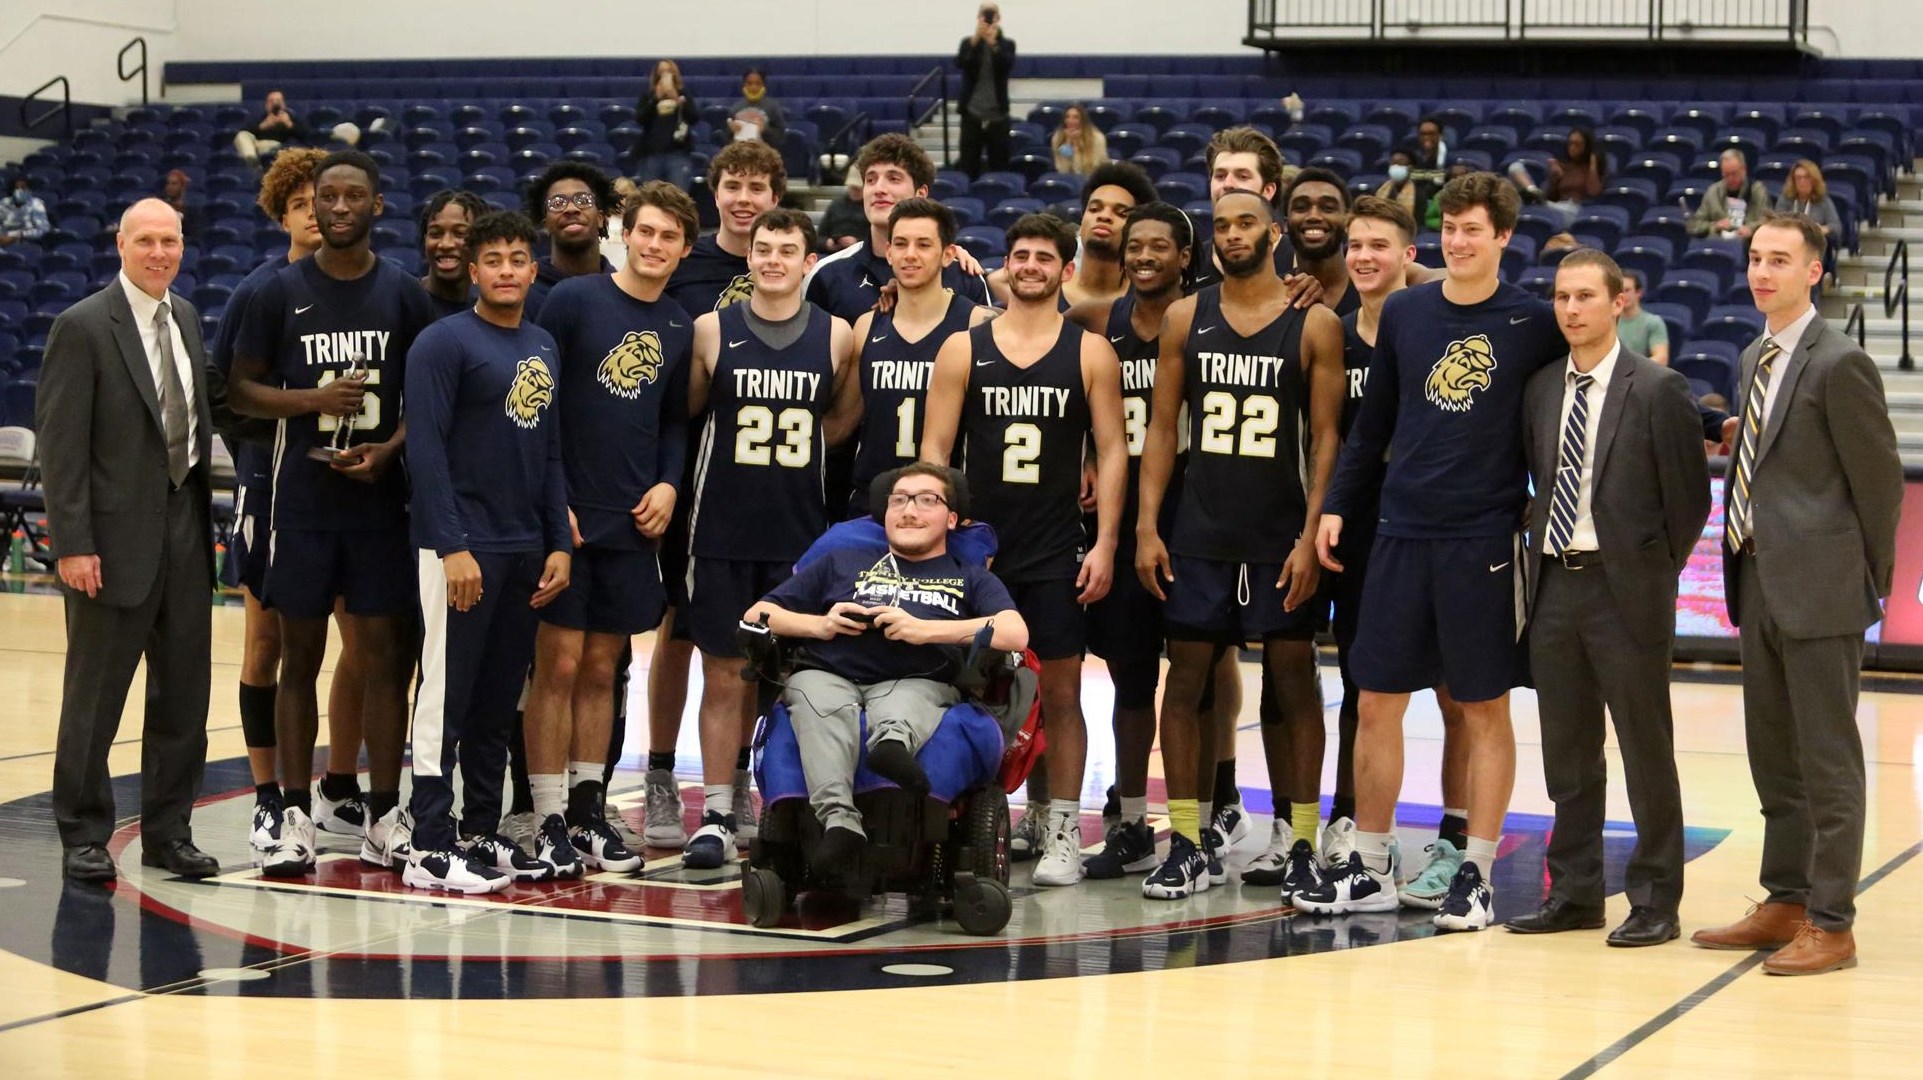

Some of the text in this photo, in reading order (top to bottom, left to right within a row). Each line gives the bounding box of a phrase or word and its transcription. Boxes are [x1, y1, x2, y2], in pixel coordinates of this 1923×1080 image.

[300, 330, 390, 365] TRINITY
[733, 368, 821, 402] TRINITY
[871, 360, 935, 391] TRINIT
[1197, 352, 1284, 388] TRINITY
[981, 386, 1070, 418] TRINITY
[734, 405, 814, 468] 23
[895, 397, 916, 457] 1
[1200, 390, 1279, 458] 22
[1002, 422, 1042, 484] 2
[912, 578, 965, 587] COLLEGE
